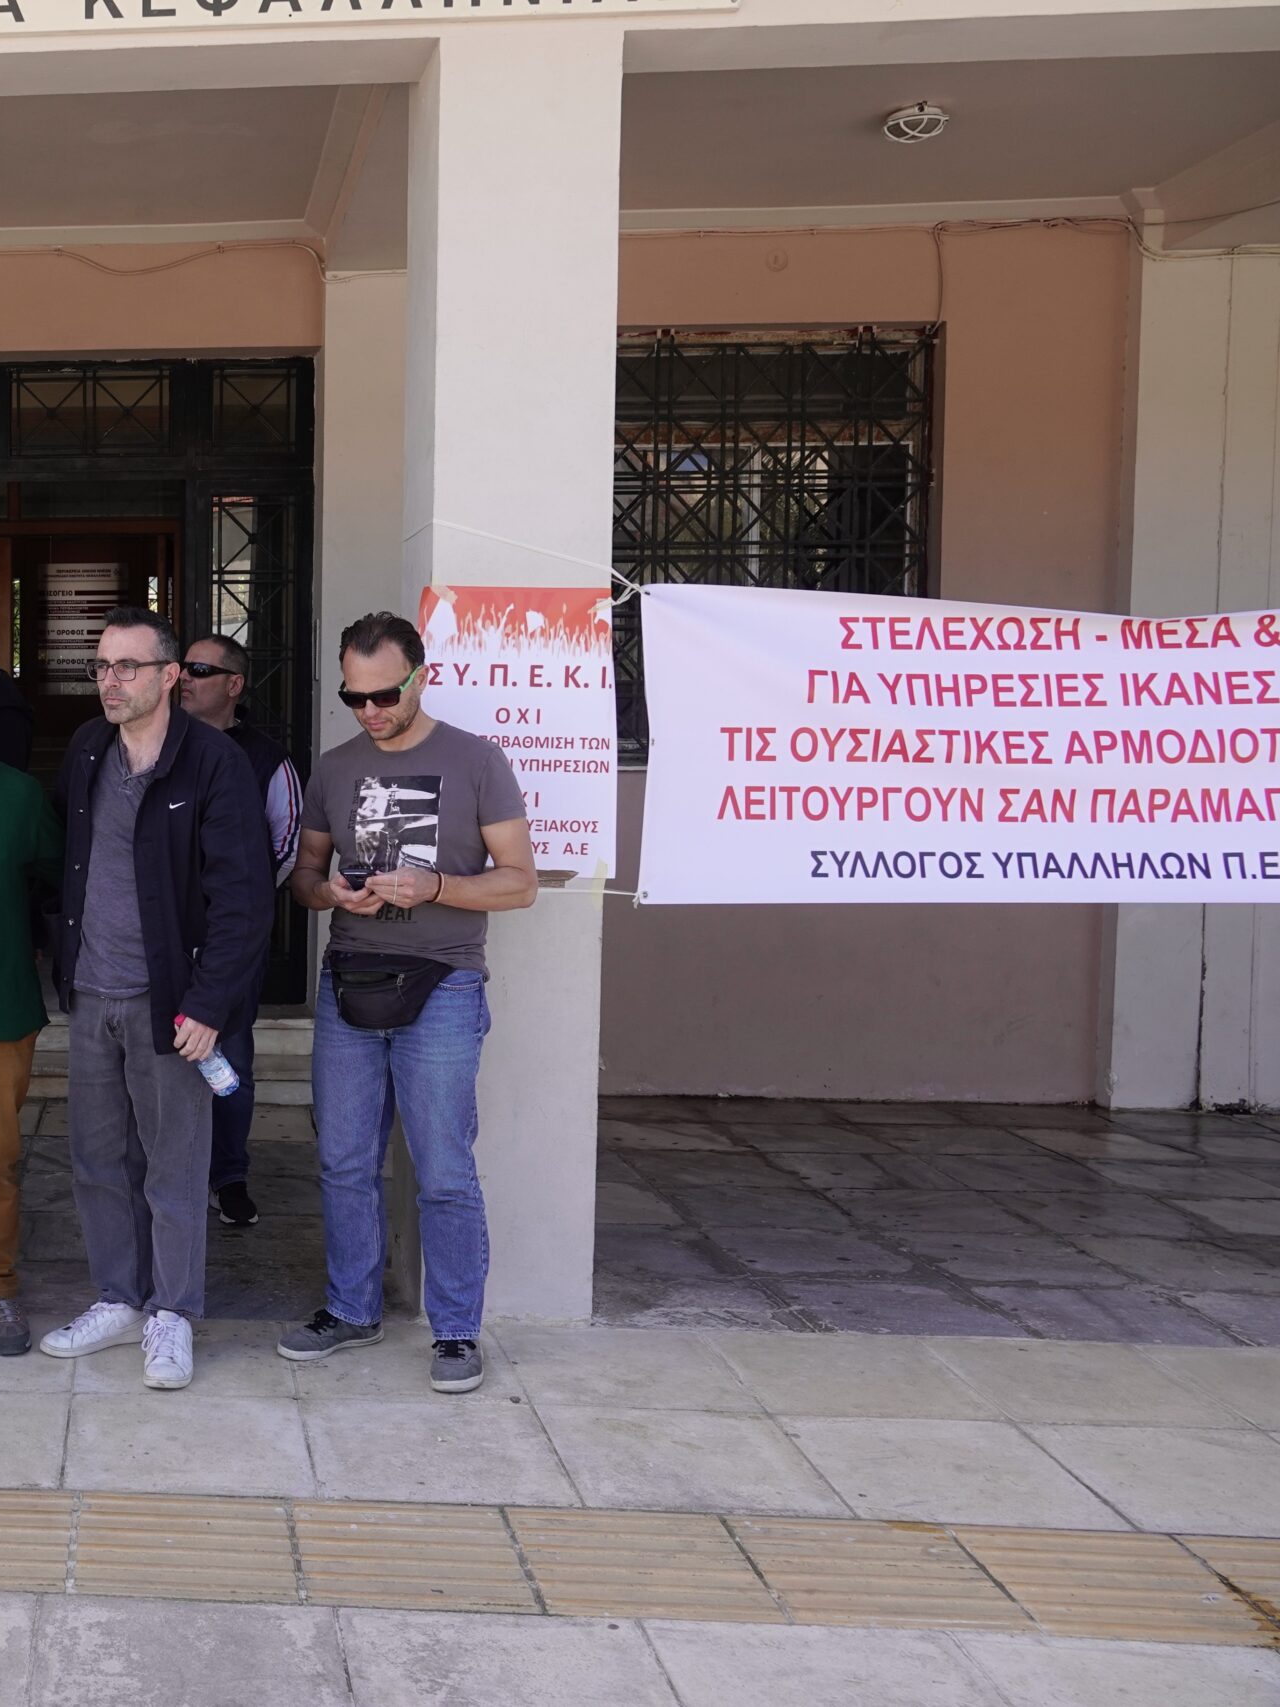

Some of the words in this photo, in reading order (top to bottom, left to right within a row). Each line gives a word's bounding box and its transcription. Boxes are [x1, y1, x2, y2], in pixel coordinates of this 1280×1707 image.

[840, 616, 1081, 651] ΣΤΕΛΕΧΩΣΗ
[1120, 616, 1240, 650] ΜΕΣΑ
[806, 669, 871, 705] ΓΙΑ
[879, 672, 1108, 708] ΥΠΗΡΕΣΙΕΣ
[1120, 670, 1280, 707] ΙΚΑΝΕΣ
[579, 737, 611, 751] ΤΩΝ
[720, 726, 777, 763] ΤΙΣ
[790, 727, 1053, 766] ΟΥΣΙΑΣΤΙΚΕΣ
[1064, 727, 1280, 765] ΑΡΜΟΔΙΟΤ
[519, 759, 610, 774] ΥΠΗΡΕΣΙΩΝ
[717, 785, 985, 823] ΛΕΙΤΟΥΡΓΟΥΝ
[997, 788, 1078, 824] ΣΑΝ
[810, 850, 985, 880] ΣΥΛΛΟΓΟΣ
[991, 851, 1212, 881] ΥΠΑΛΛΗΛΩΝ
